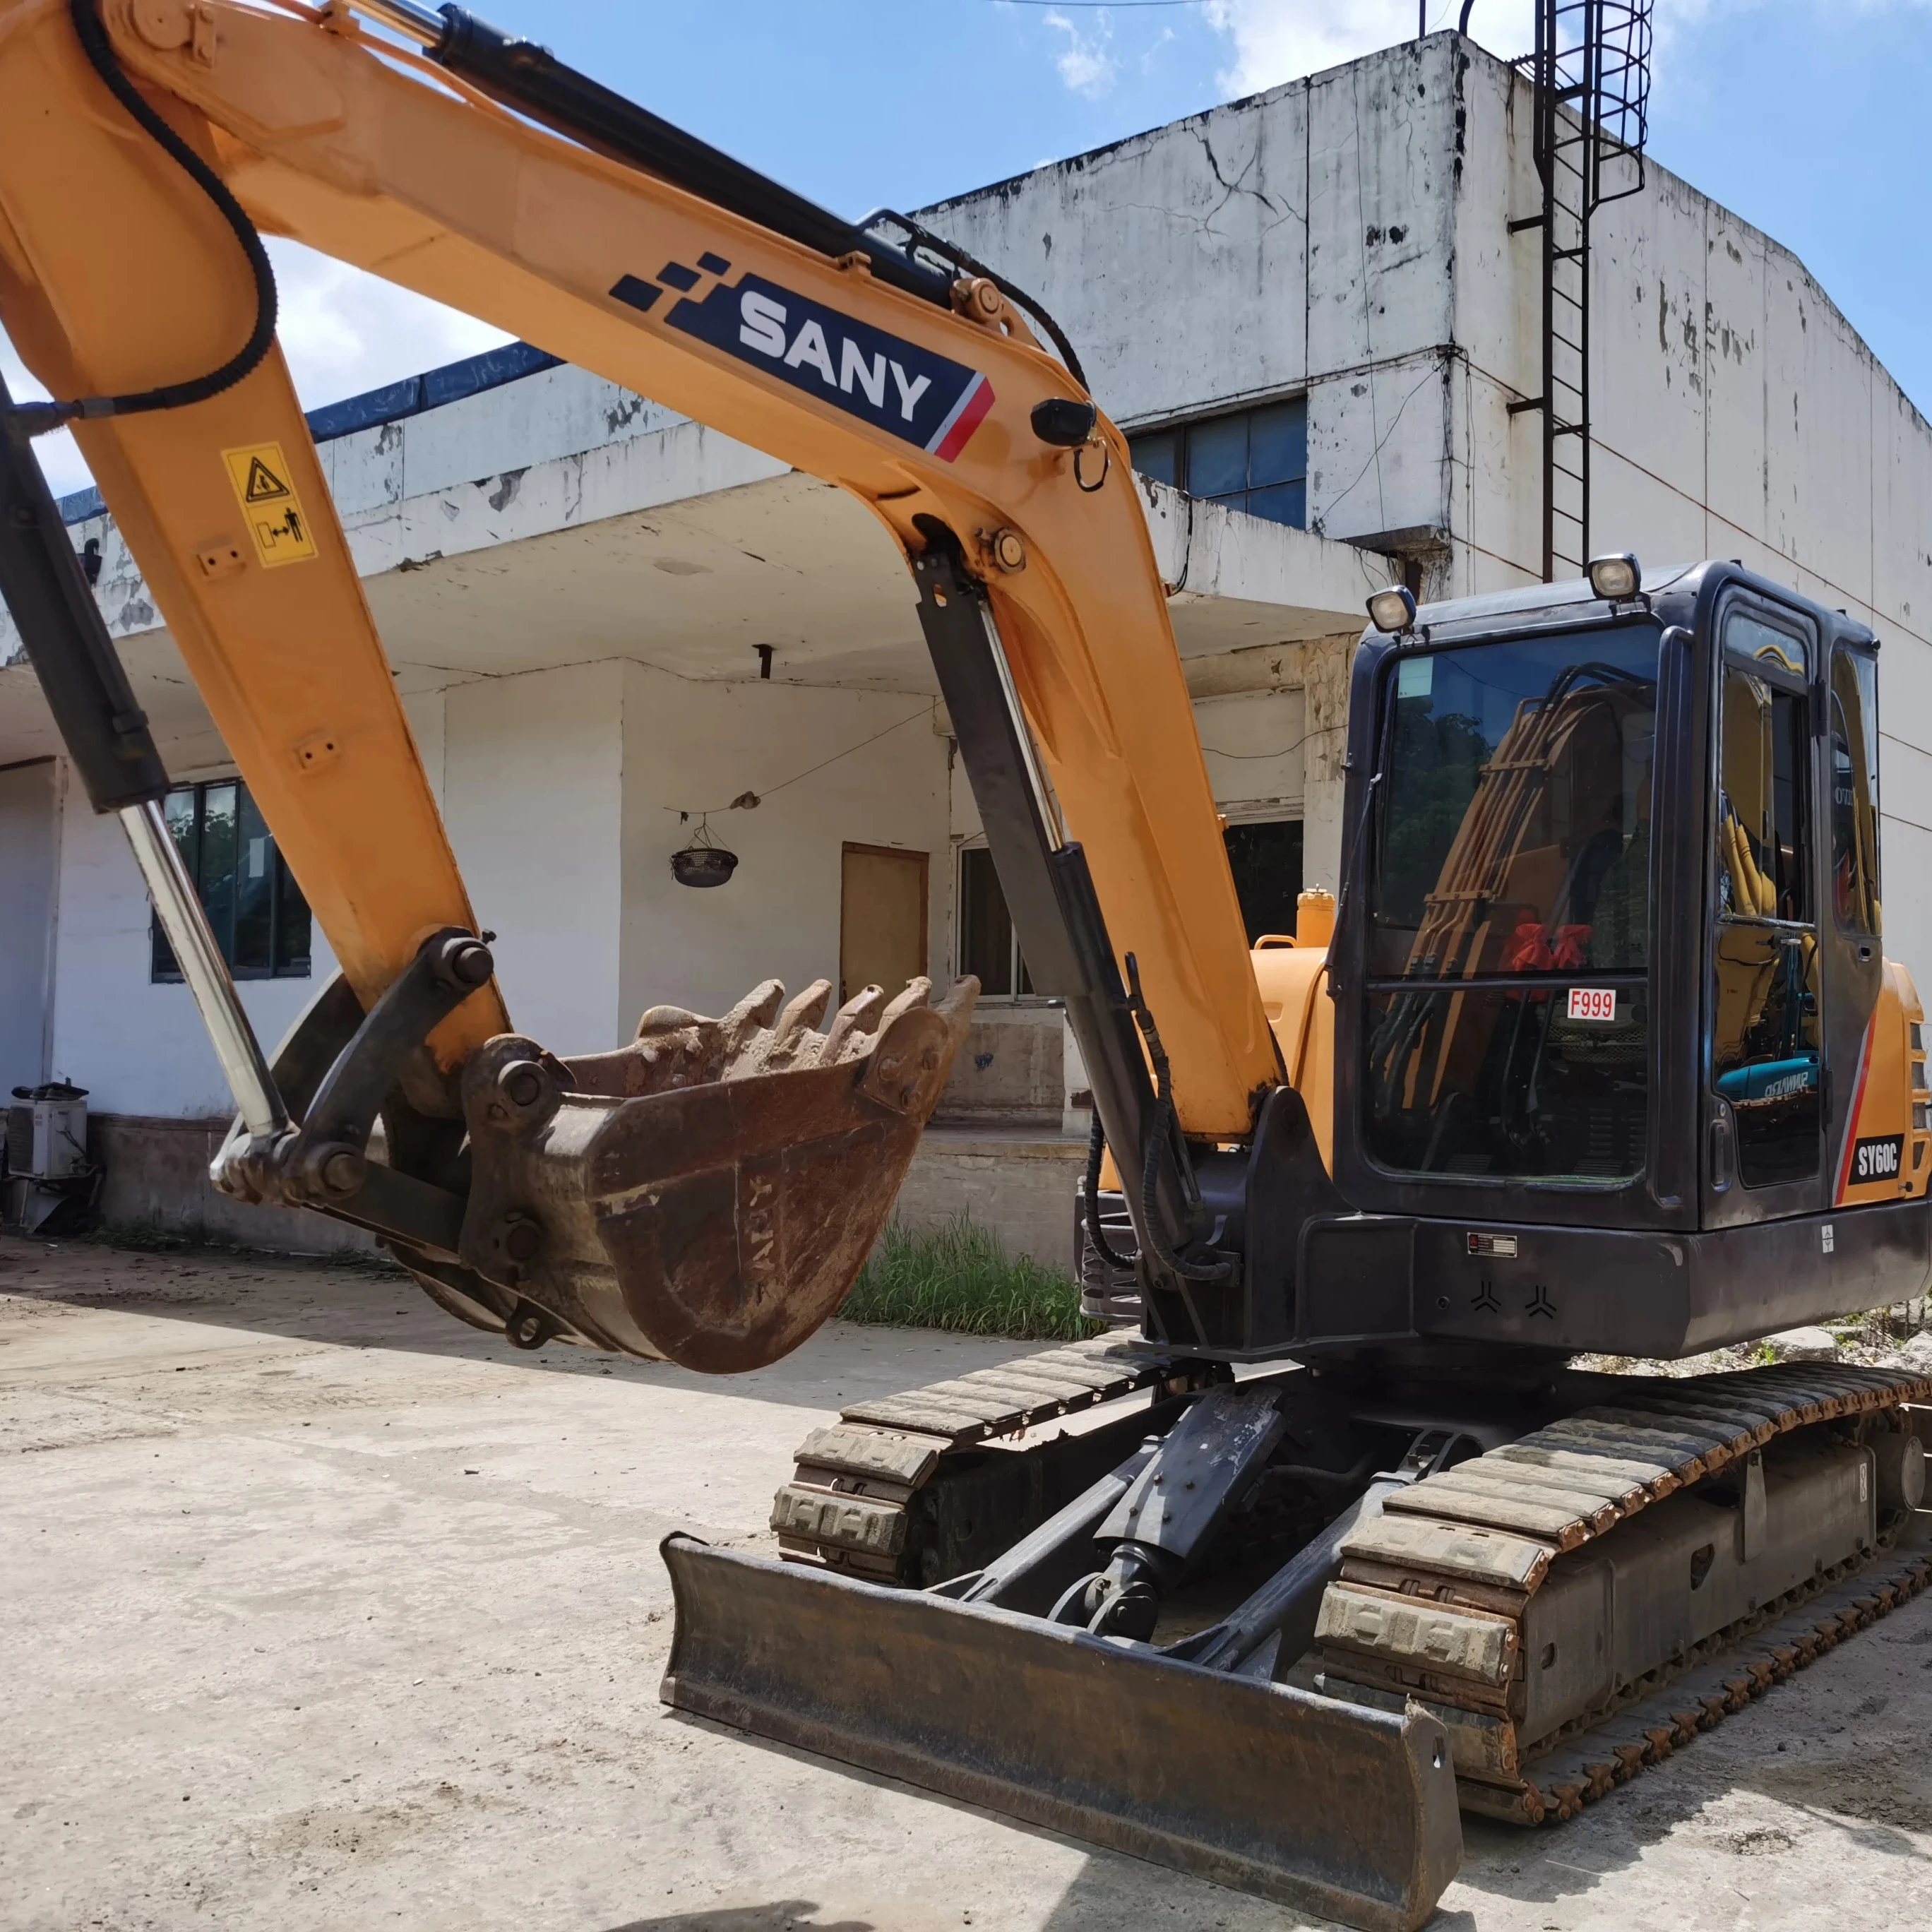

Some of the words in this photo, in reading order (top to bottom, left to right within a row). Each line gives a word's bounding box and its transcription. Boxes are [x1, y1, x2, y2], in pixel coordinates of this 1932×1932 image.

[739, 290, 931, 422] SANY
[1571, 991, 1612, 1018] F999
[1858, 1142, 1897, 1176] SY60C
